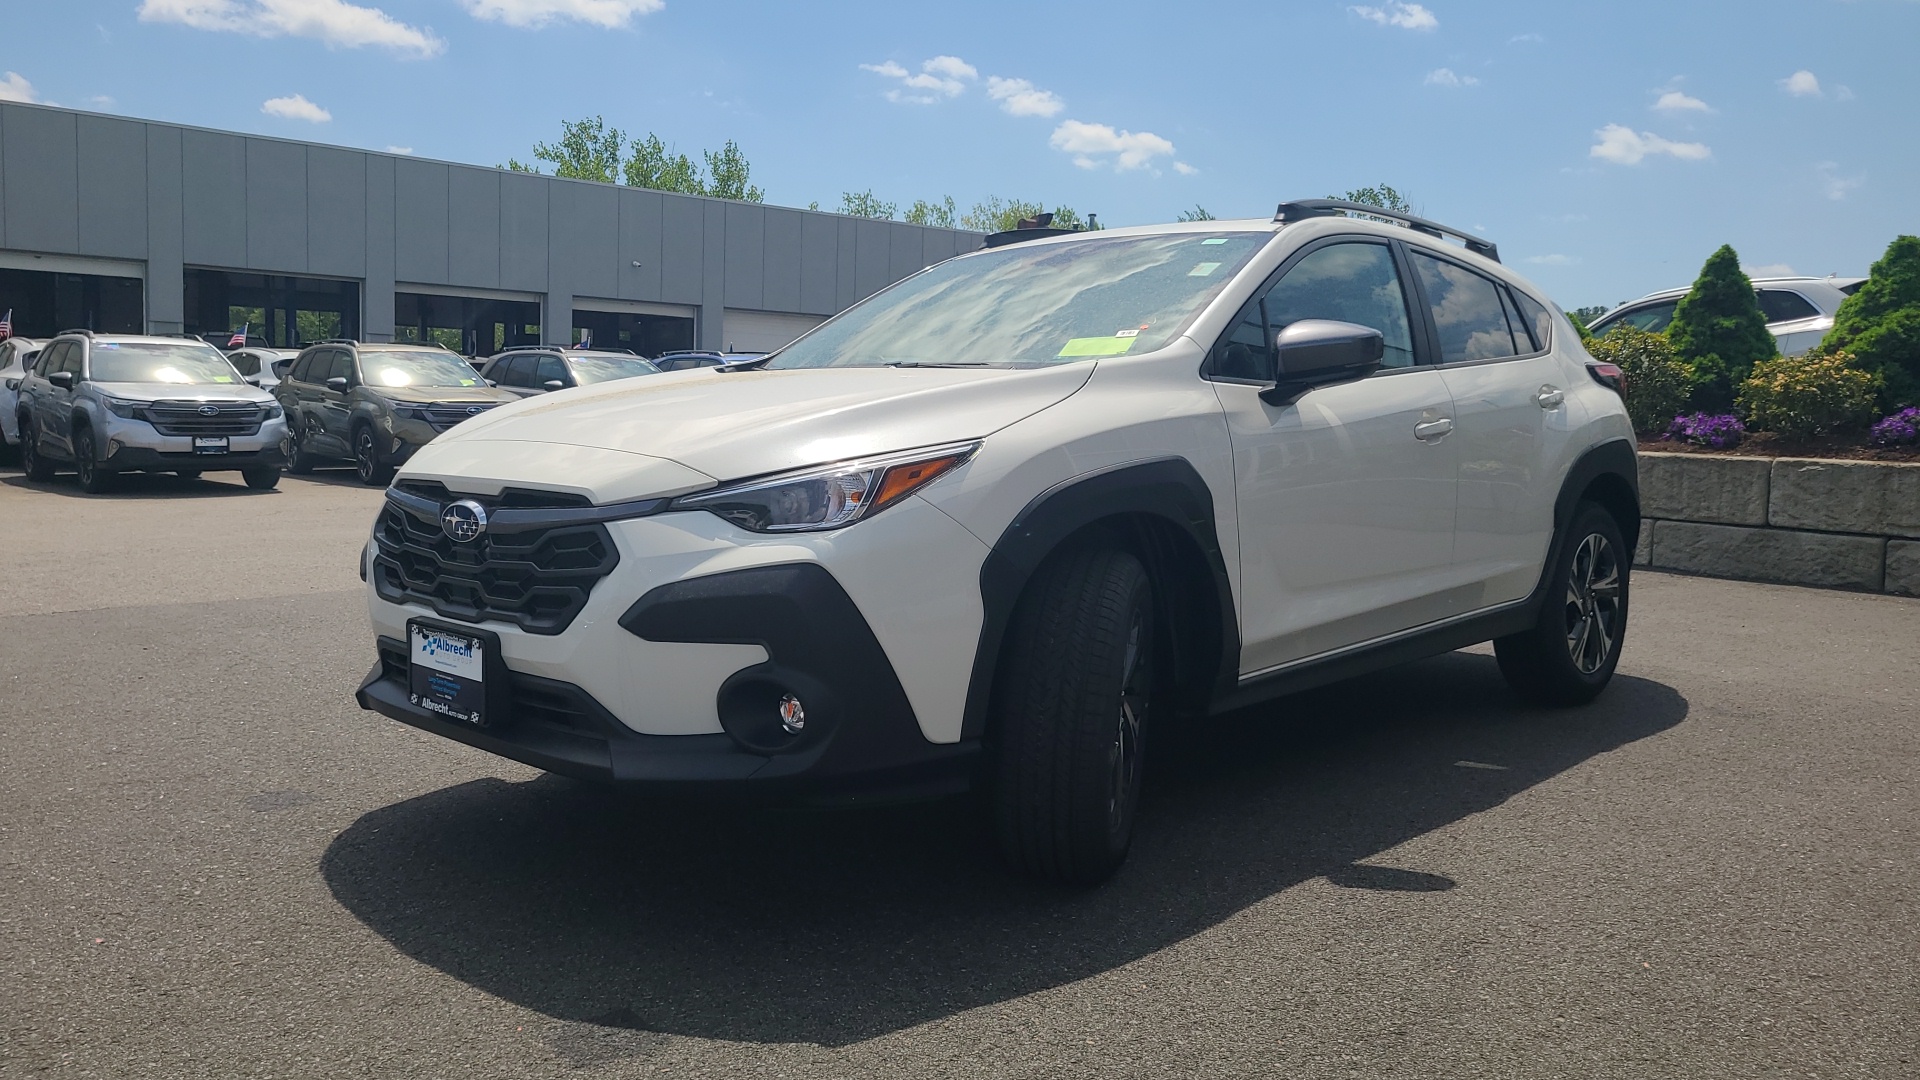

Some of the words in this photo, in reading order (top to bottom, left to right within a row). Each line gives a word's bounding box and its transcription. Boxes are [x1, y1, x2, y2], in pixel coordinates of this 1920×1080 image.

[436, 651, 451, 659] AUTO
[453, 655, 472, 665] GROUP
[437, 638, 472, 658] Albrecht
[422, 697, 449, 715] Albrecht
[457, 713, 468, 721] GROUP
